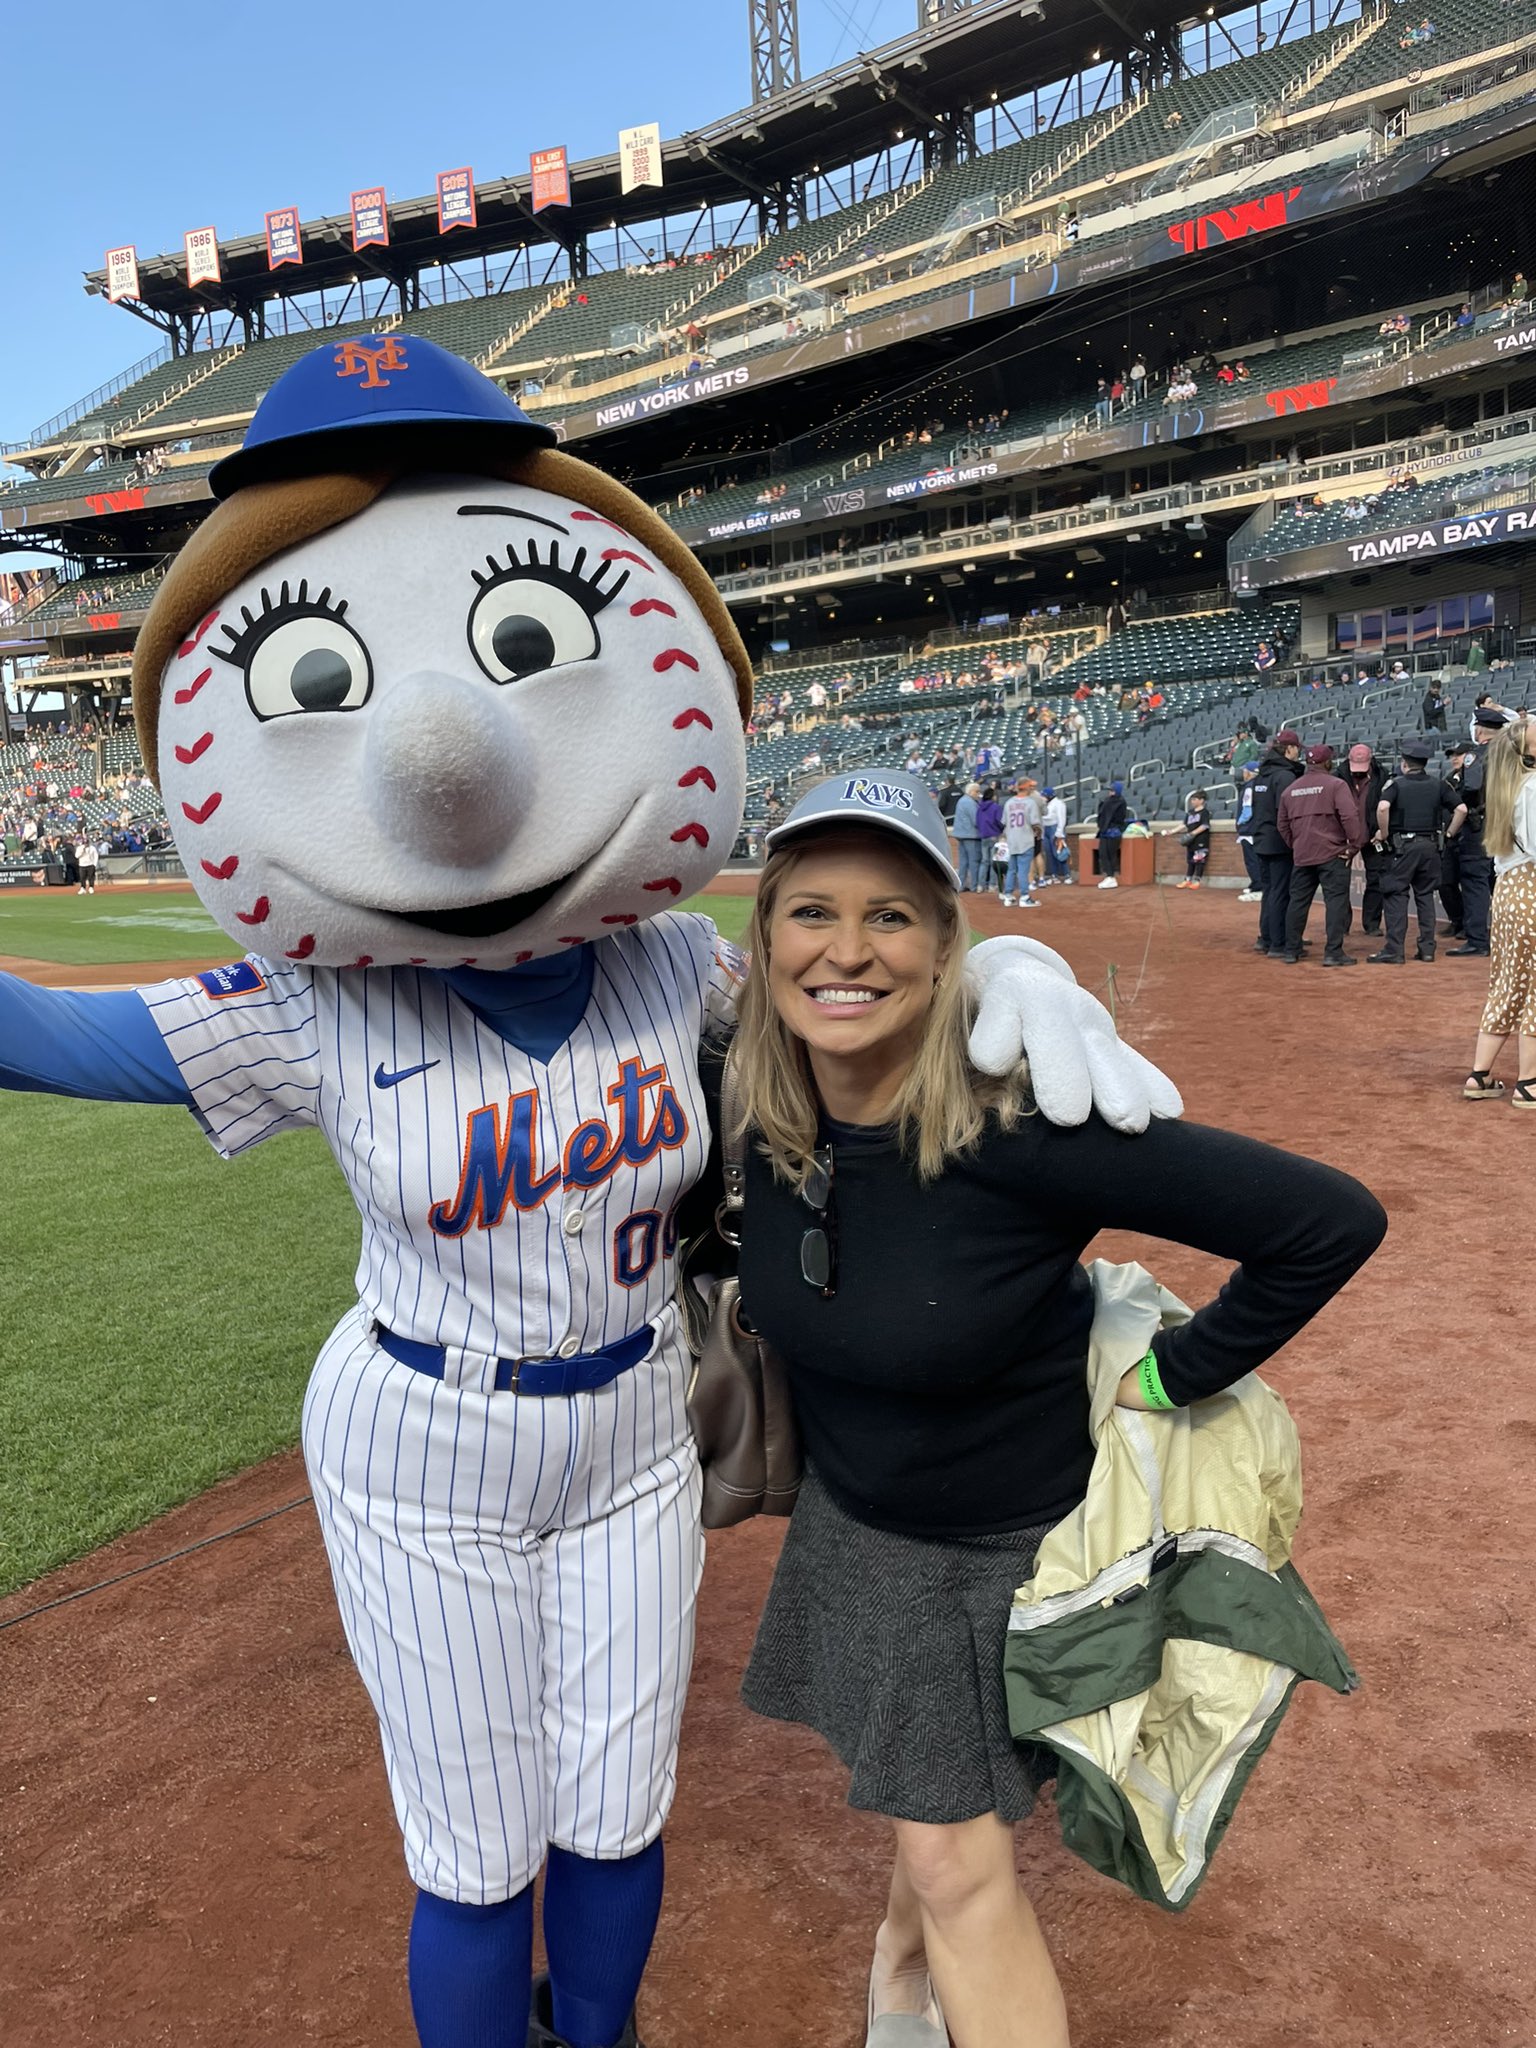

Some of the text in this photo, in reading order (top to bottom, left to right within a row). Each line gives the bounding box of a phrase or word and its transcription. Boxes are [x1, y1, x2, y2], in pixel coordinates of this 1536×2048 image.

[442, 173, 468, 192] 2015
[354, 192, 381, 211] 2000
[270, 213, 293, 230] 1973
[190, 233, 211, 248] 1986
[111, 251, 131, 266] 1969
[334, 337, 409, 389] NY
[596, 367, 750, 426] NEW YORK METS
[1407, 447, 1483, 473] HYUNDAI CLUB
[886, 463, 998, 498] NEW YORK METS
[823, 489, 866, 517] VS
[708, 508, 802, 537] TAMPA BAY RAYS
[1348, 530, 1437, 562] TAMPA
[1443, 516, 1499, 544] BAY
[840, 778, 914, 811] RAYS
[1290, 786, 1324, 797] SECURITY
[1010, 812, 1025, 828] 20
[428, 1056, 689, 1239] Mets
